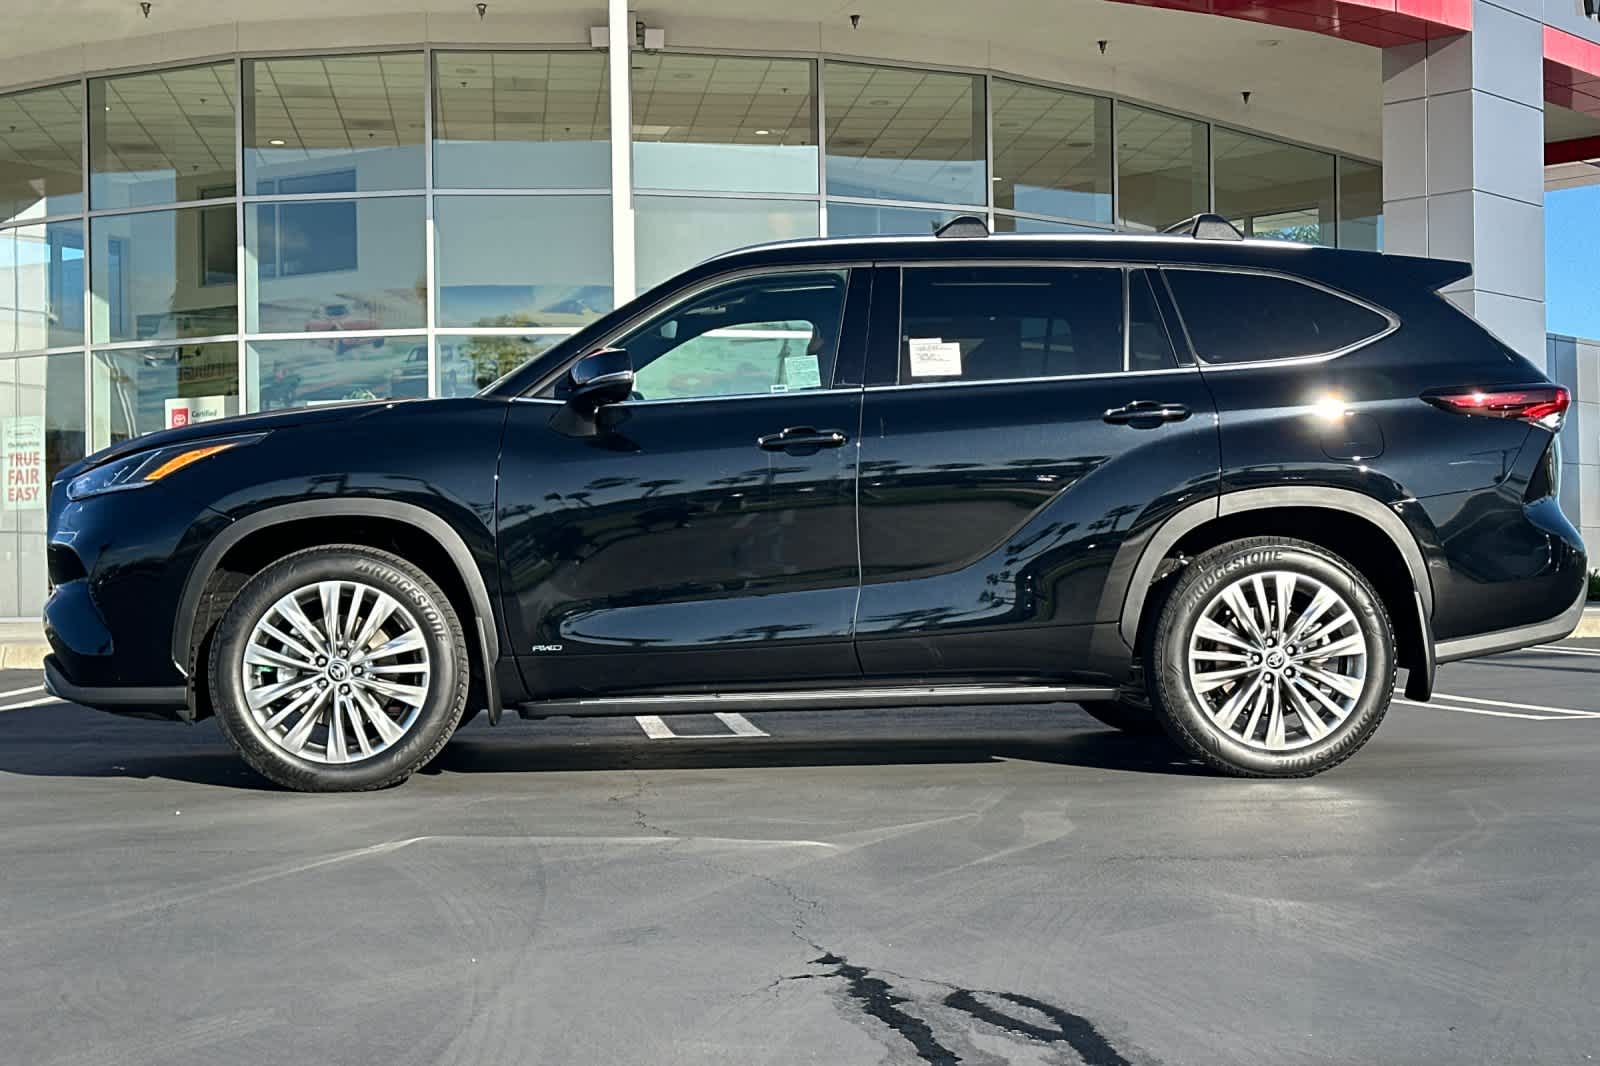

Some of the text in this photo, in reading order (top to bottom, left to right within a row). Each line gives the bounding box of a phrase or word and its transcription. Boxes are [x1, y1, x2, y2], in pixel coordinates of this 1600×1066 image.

[8, 451, 40, 467] TRUE
[8, 468, 39, 485] FAIR
[8, 486, 40, 502] EASY
[353, 560, 446, 641] BRIDGESTONE
